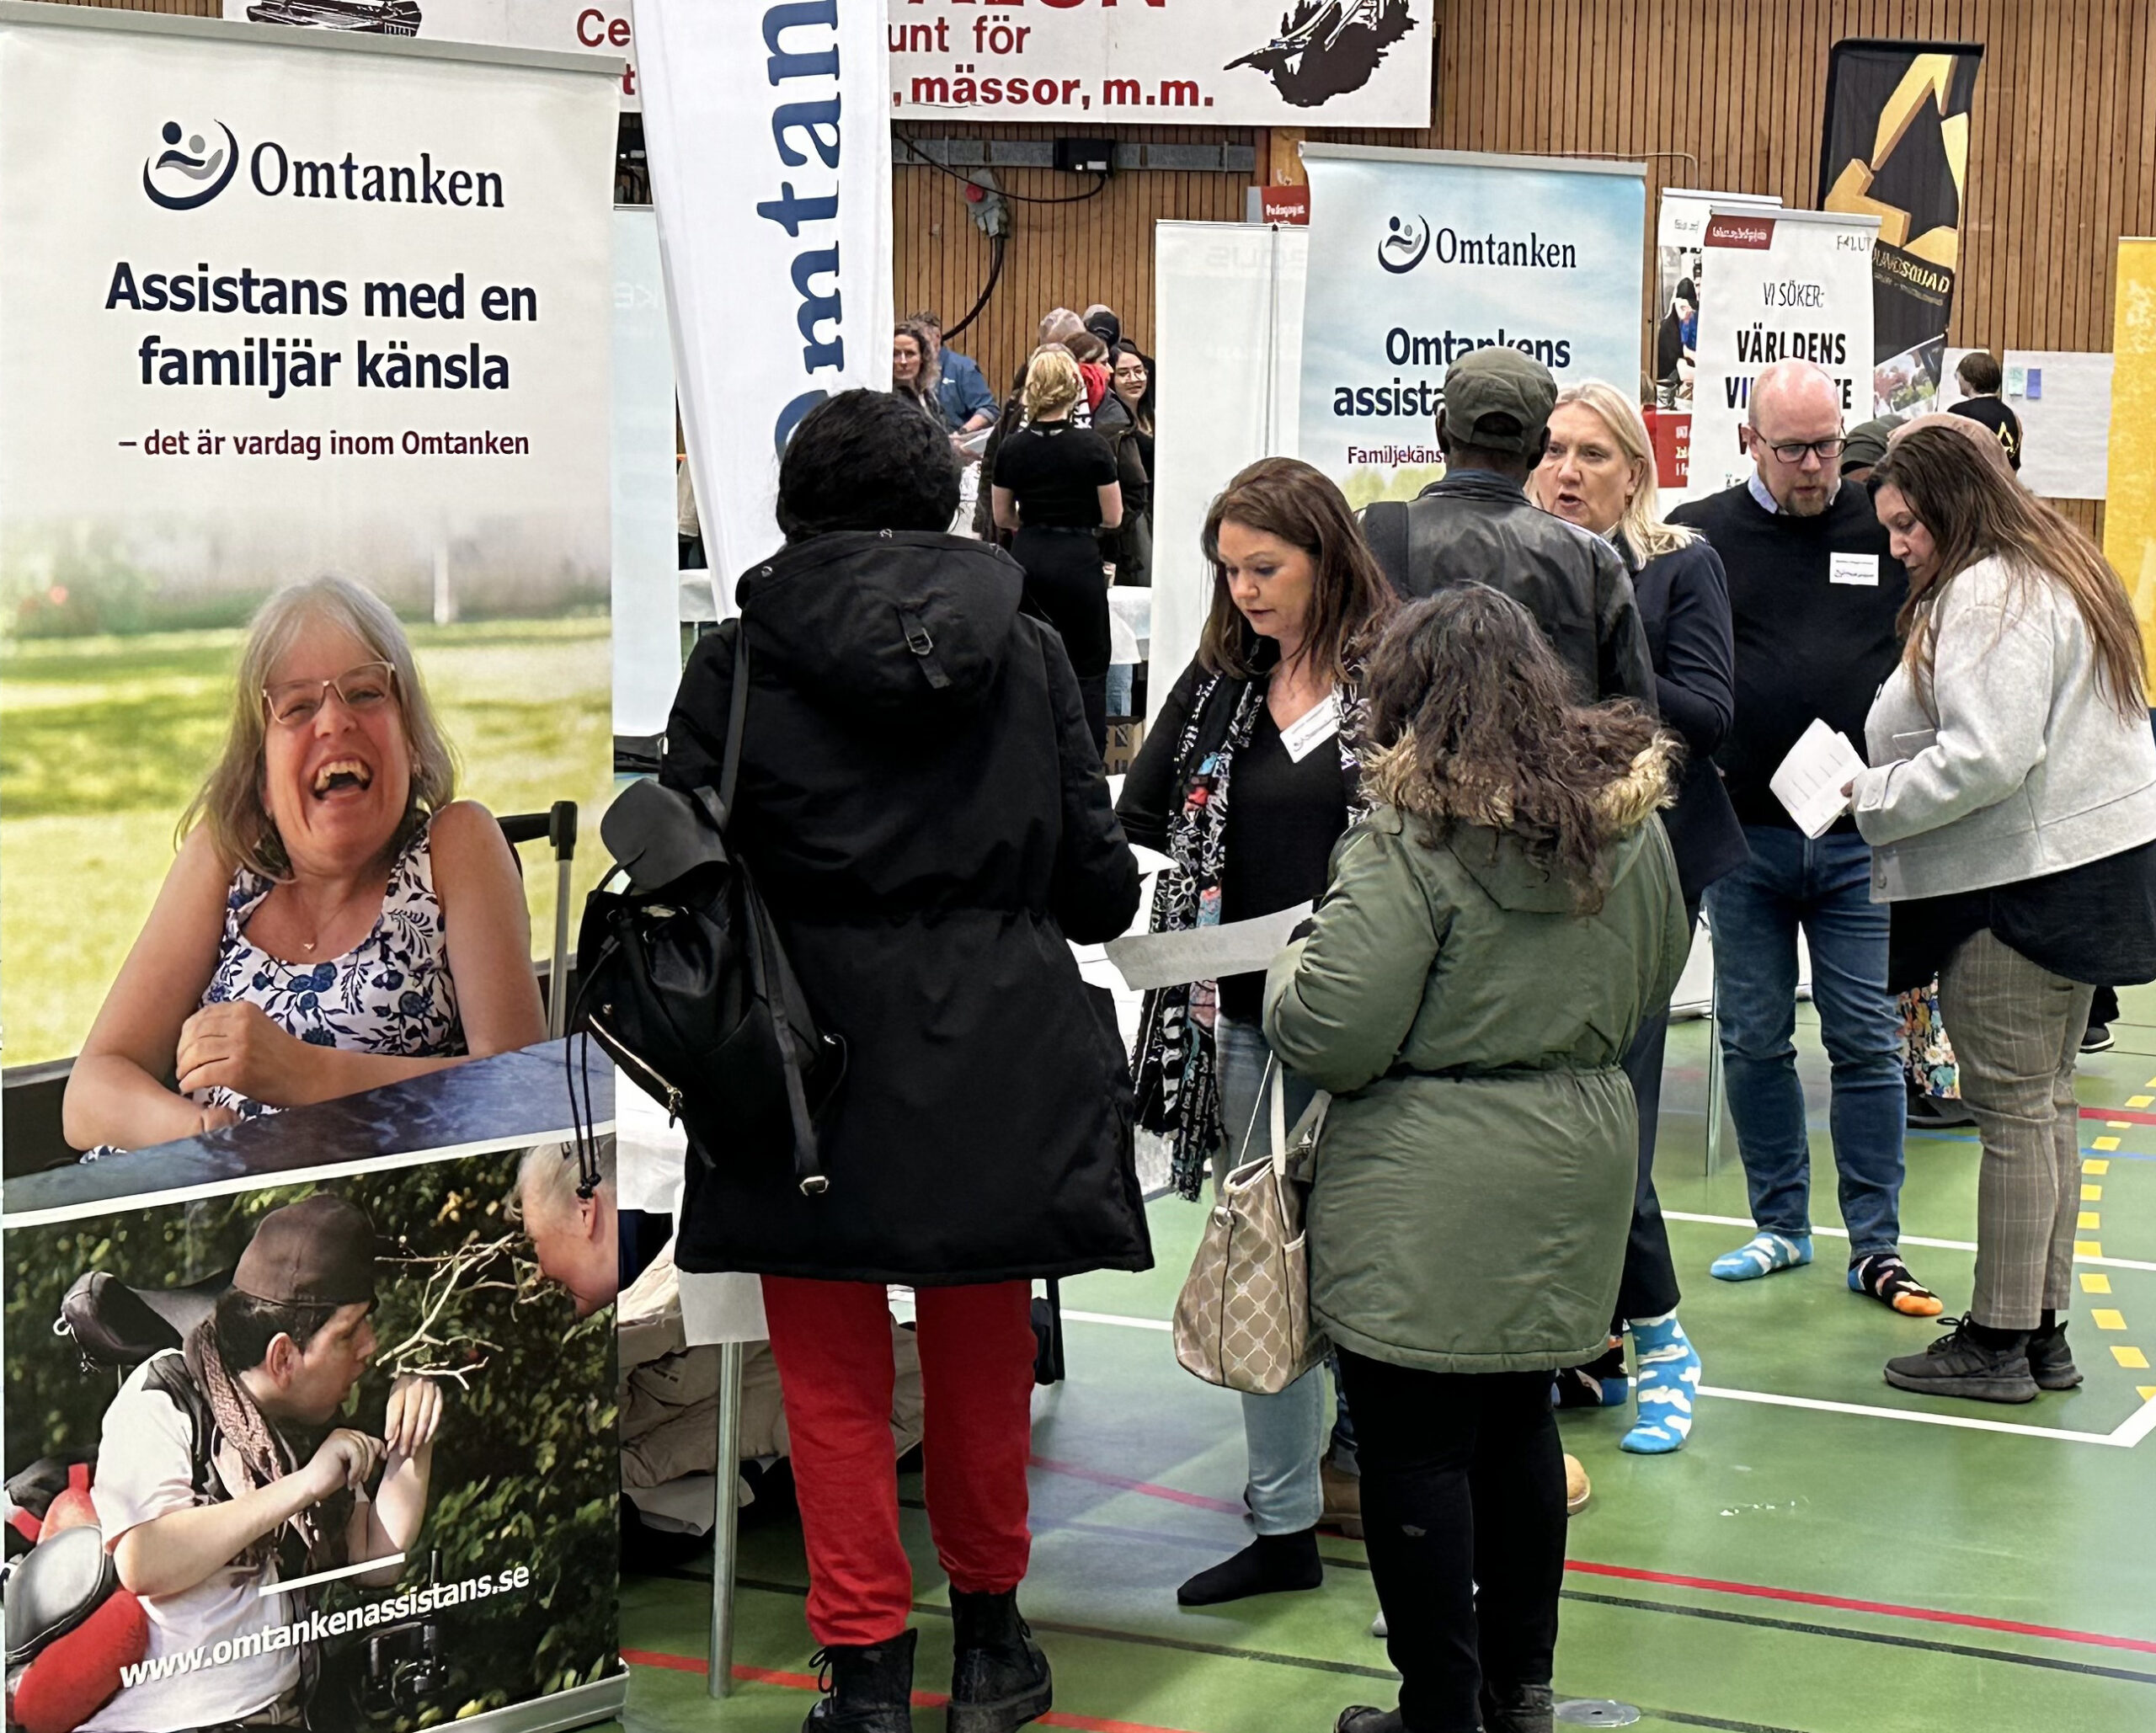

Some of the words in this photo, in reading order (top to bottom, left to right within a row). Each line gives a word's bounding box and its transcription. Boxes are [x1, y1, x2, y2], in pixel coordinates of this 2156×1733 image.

[973, 15, 1031, 54] för
[911, 64, 1091, 110] mässor,
[1102, 78, 1214, 107] m.m.
[251, 142, 505, 208] Omtanken
[1436, 228, 1577, 269] Omtanken
[105, 263, 348, 317] Assistans
[365, 274, 465, 321] med
[481, 286, 538, 322] en
[1737, 323, 1847, 365] VÄRLDENS
[139, 335, 341, 400] familjär
[358, 340, 510, 391] känsla
[144, 429, 191, 456] det
[198, 429, 227, 456] är
[233, 429, 322, 462] vardag
[330, 429, 395, 457] inom
[402, 430, 530, 457] Omtanken
[120, 1562, 531, 1688] www.omtankenassistans.se
